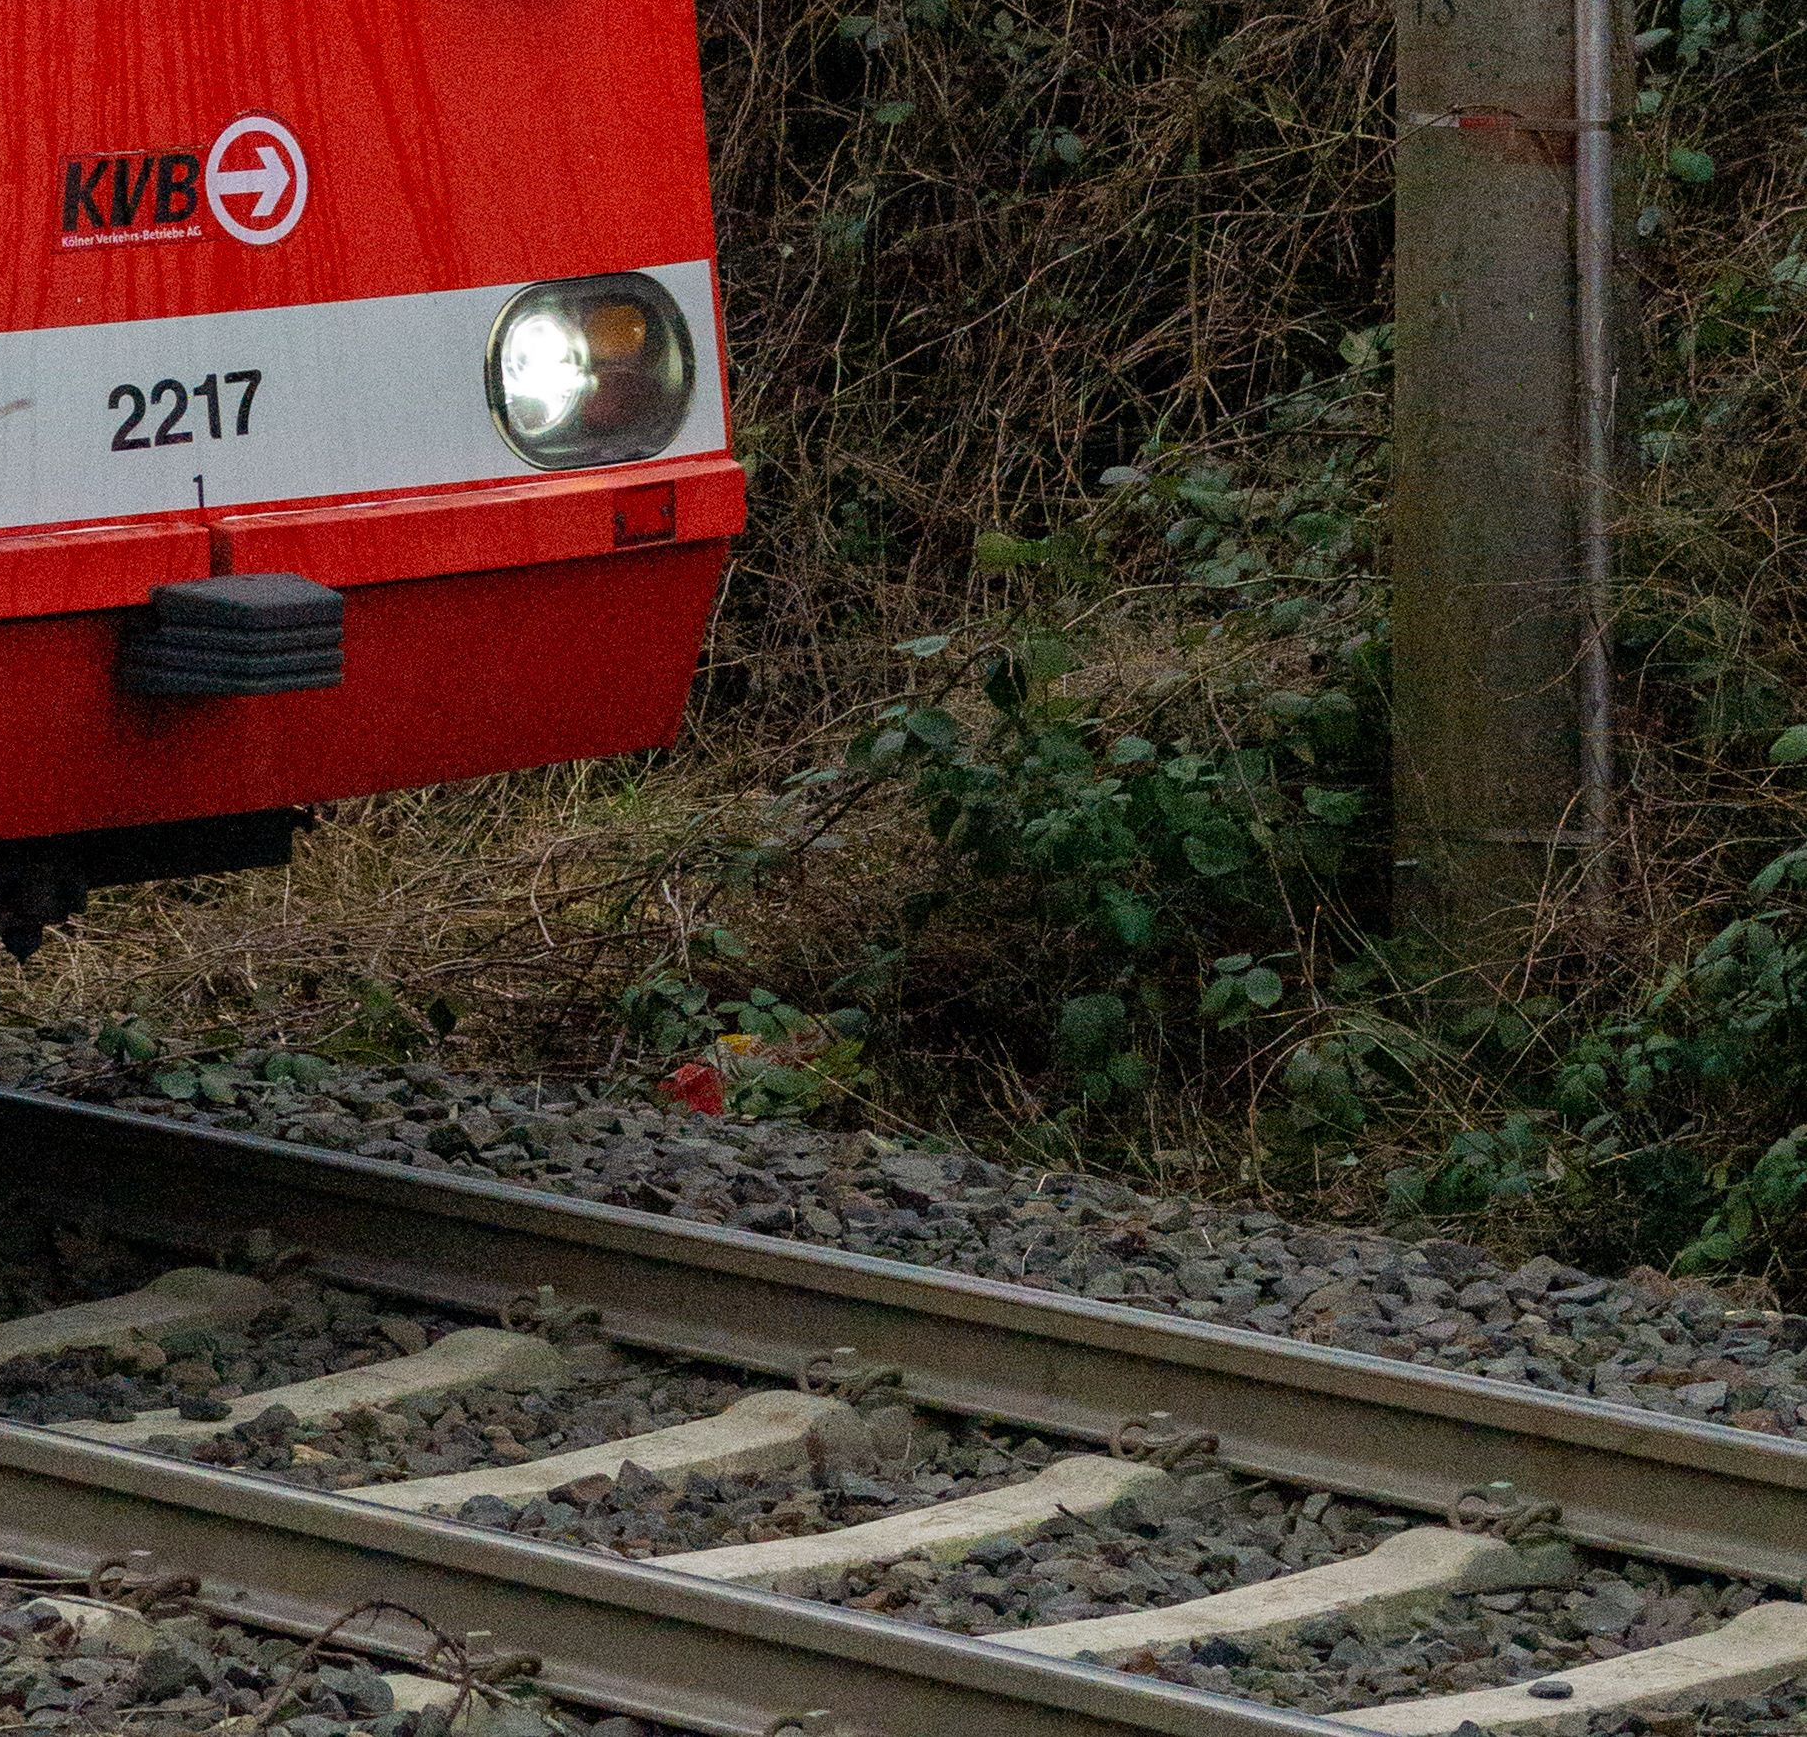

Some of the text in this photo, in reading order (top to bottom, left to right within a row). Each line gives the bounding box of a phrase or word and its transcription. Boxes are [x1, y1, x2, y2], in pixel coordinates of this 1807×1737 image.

[62, 153, 200, 231] KVB
[61, 225, 203, 248] Kölner Verkehrs-Betriebe AG
[107, 369, 263, 453] 2217
